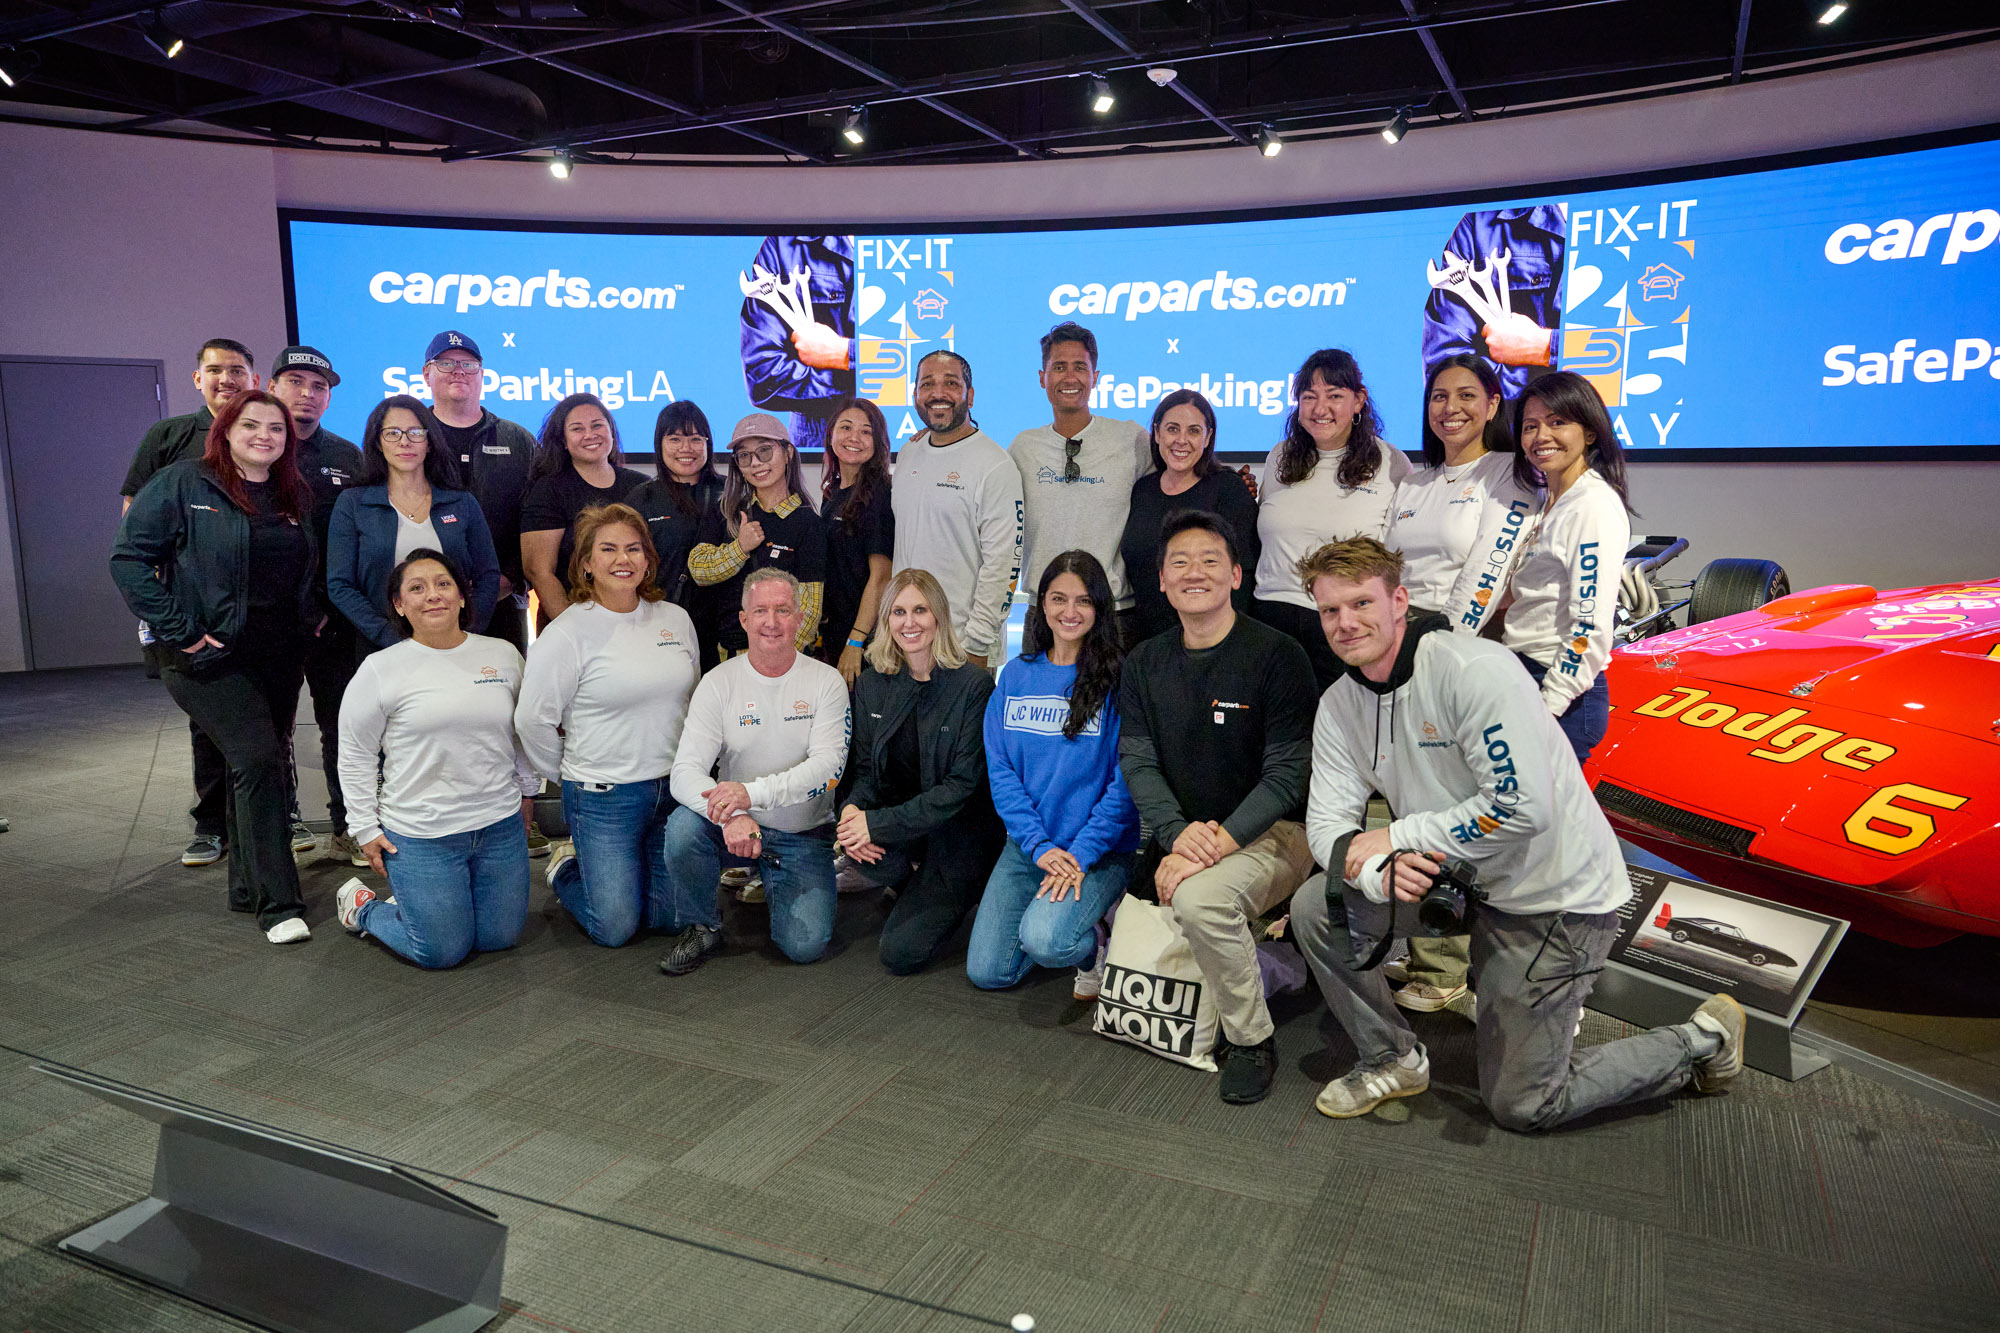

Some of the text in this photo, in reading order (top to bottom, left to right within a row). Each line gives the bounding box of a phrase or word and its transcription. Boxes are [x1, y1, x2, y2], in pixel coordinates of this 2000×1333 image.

[1570, 199, 1698, 247] FIX-IT
[1824, 208, 2000, 265] carp
[857, 238, 953, 270] FIX-IT
[369, 269, 677, 313] carparts.com
[1049, 270, 1347, 321] carparts.com
[382, 366, 676, 410] SaParkingLA
[1029, 705, 1092, 725] WHIT
[1632, 685, 1898, 772] Dodge
[1841, 781, 1972, 857] 6
[1101, 965, 1196, 1016] LIQUI
[1098, 1001, 1194, 1053] MOLY
